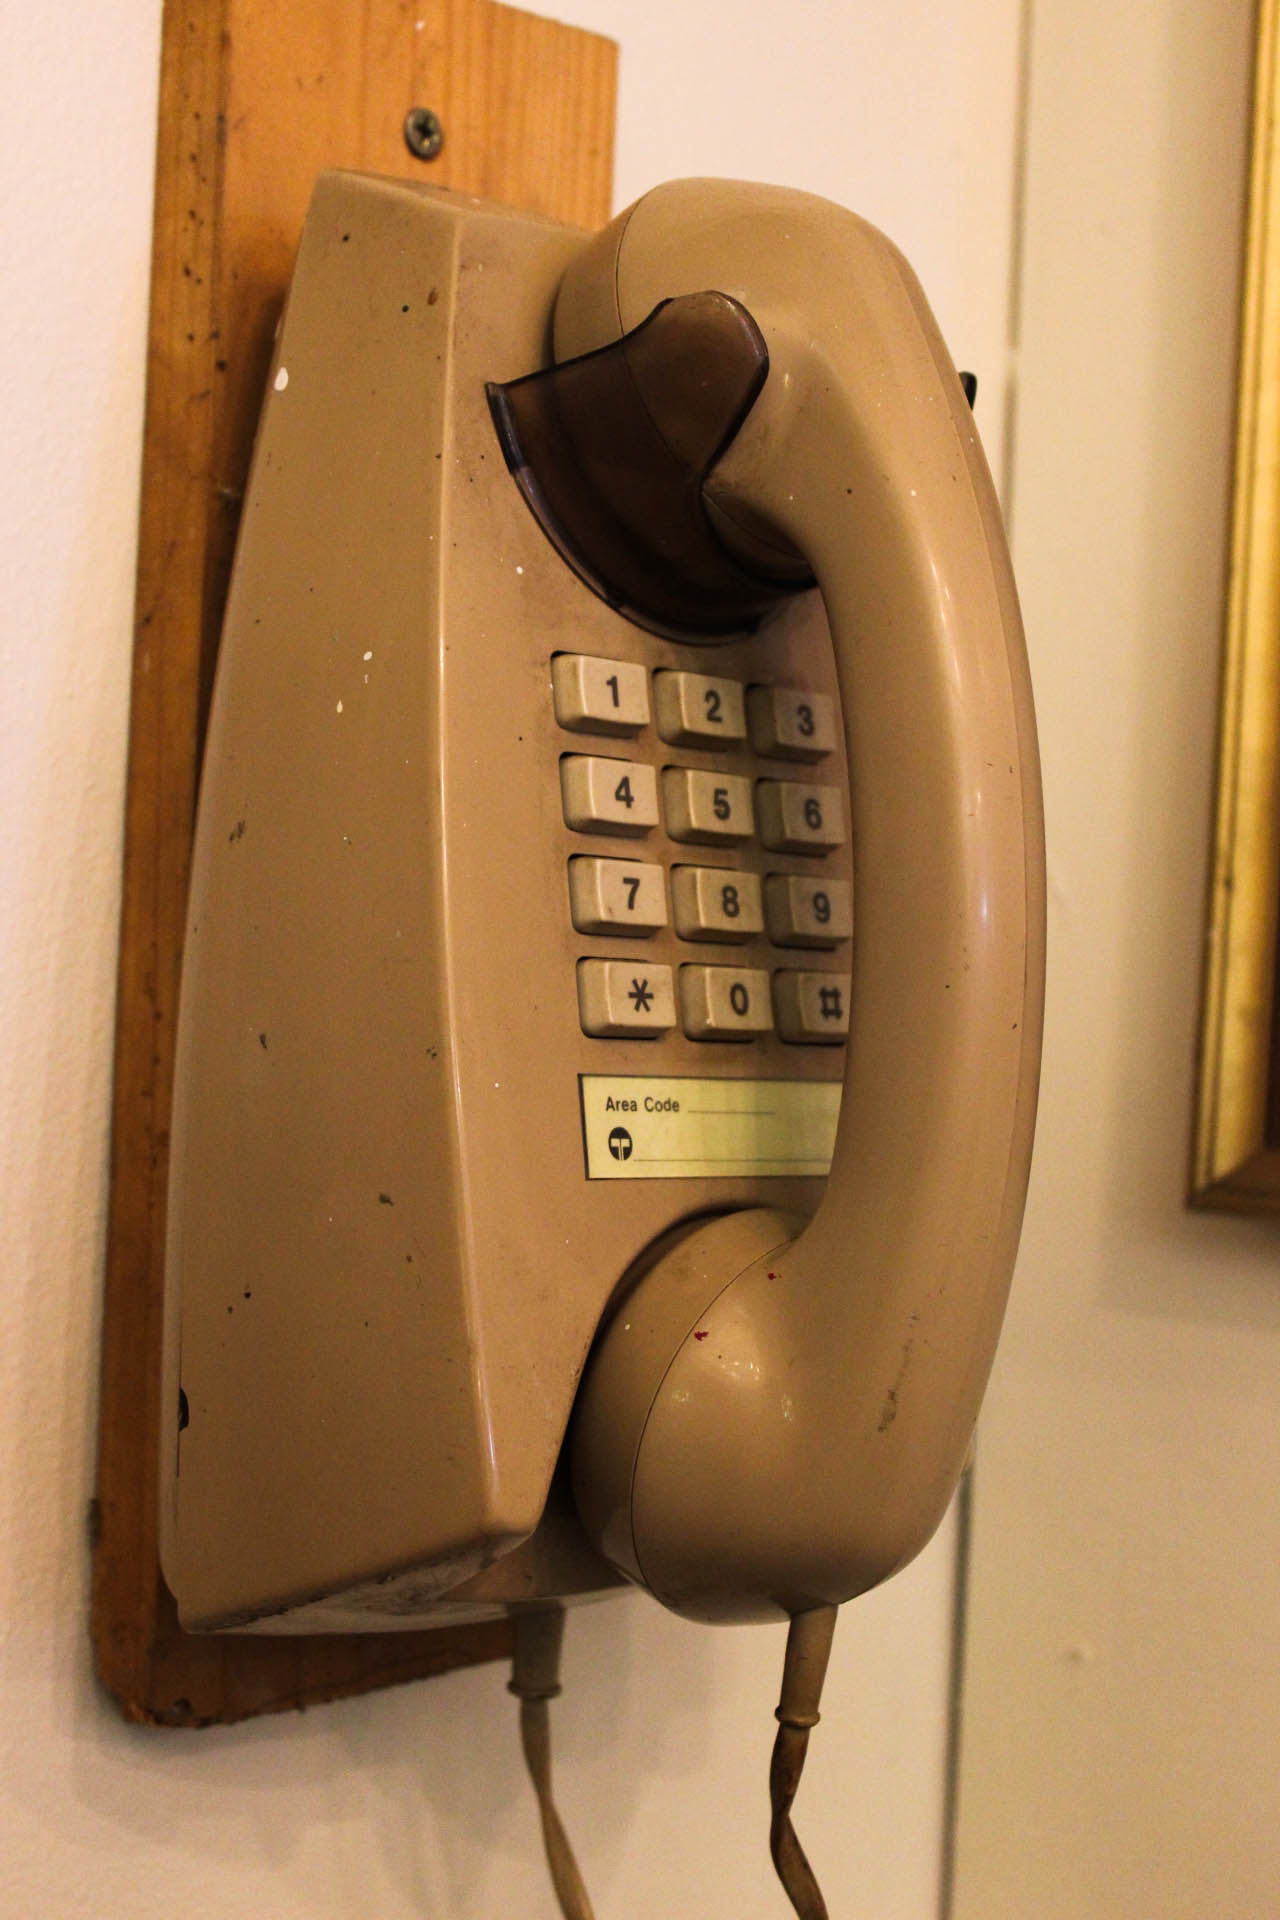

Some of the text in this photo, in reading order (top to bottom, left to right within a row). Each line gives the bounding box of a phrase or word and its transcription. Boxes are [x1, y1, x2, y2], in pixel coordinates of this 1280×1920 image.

[606, 675, 815, 736] 1 2 3
[614, 775, 822, 830] 4 5 6
[622, 877, 832, 923] 7 8 9
[729, 983, 749, 1016] 0
[605, 1096, 680, 1113] Area Code
